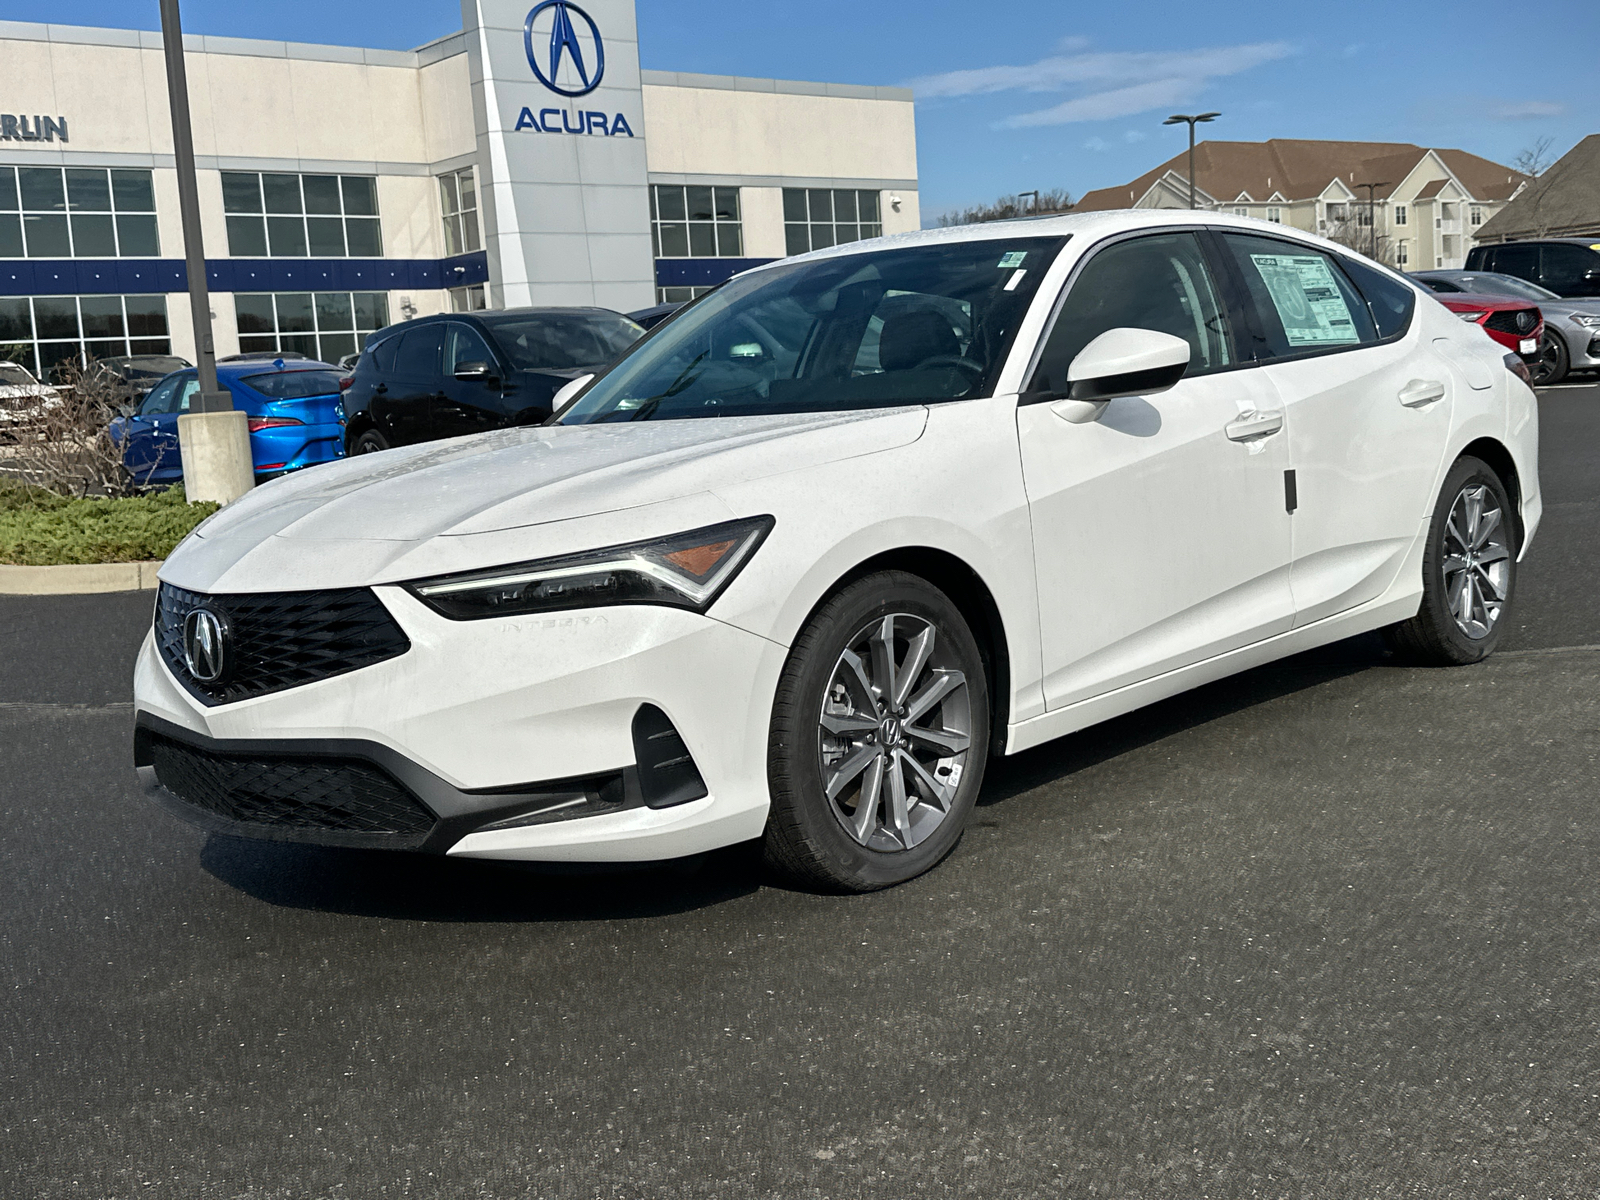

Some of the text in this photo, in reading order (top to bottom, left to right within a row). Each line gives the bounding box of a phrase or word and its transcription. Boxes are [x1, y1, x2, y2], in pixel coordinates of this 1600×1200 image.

[0, 113, 68, 142] RLIN
[515, 106, 634, 137] ACURA
[500, 615, 609, 633] INTEGRA
